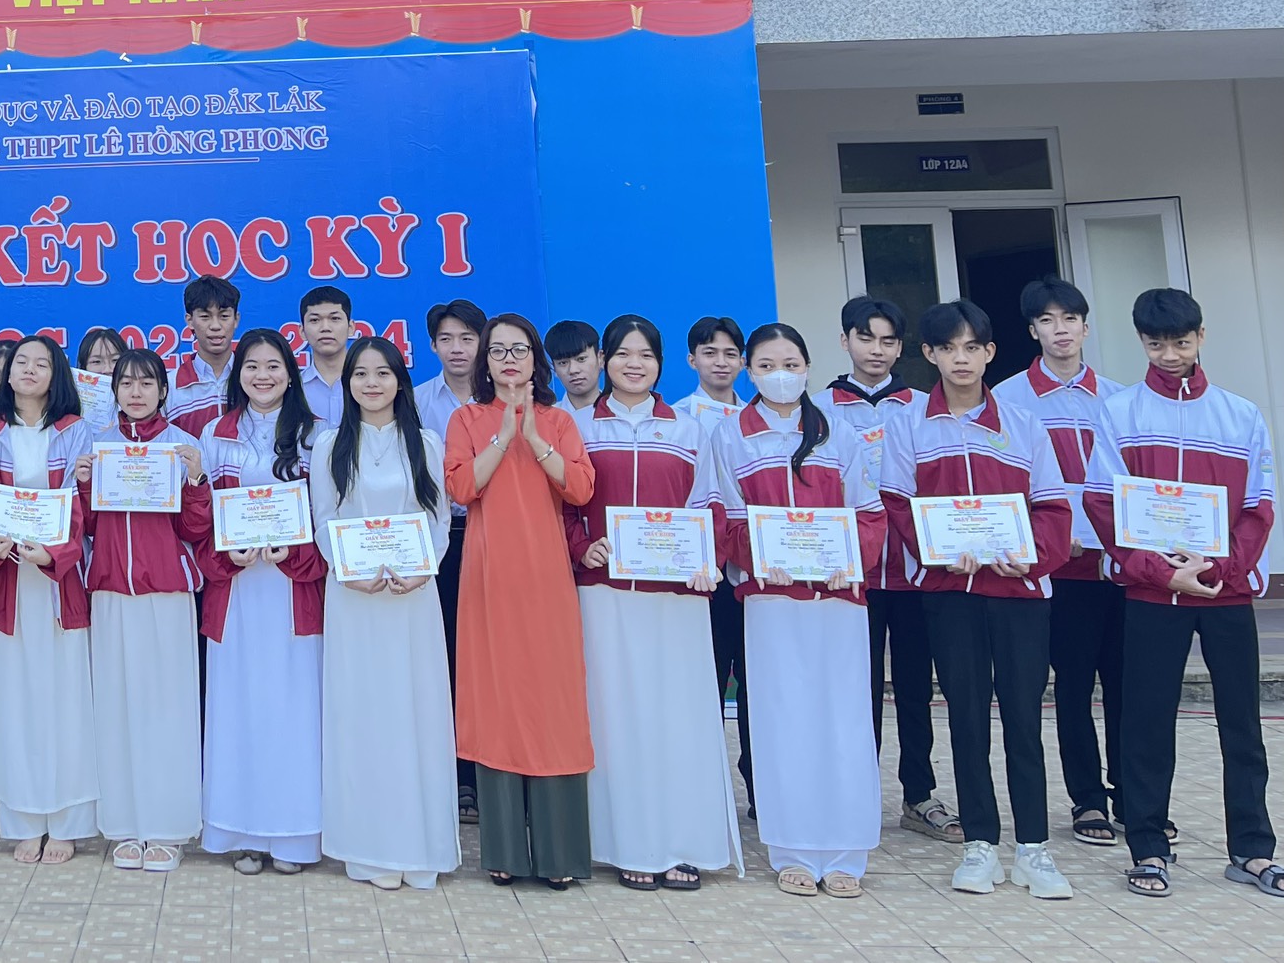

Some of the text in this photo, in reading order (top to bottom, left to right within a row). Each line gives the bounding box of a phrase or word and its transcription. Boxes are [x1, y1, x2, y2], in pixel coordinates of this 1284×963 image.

[41, 94, 81, 120] VÀ
[84, 92, 141, 120] ĐÀO
[146, 94, 201, 120] TẠO
[204, 88, 265, 115] ĐẮK
[268, 85, 325, 113] LẮK
[3, 134, 80, 159] THPT
[84, 126, 123, 157] LÊ
[128, 125, 216, 155] HỒNG
[220, 126, 329, 152] PHONG
[922, 158, 968, 170] LỚP 12A4
[305, 196, 421, 280] KỲ
[436, 211, 473, 277] I
